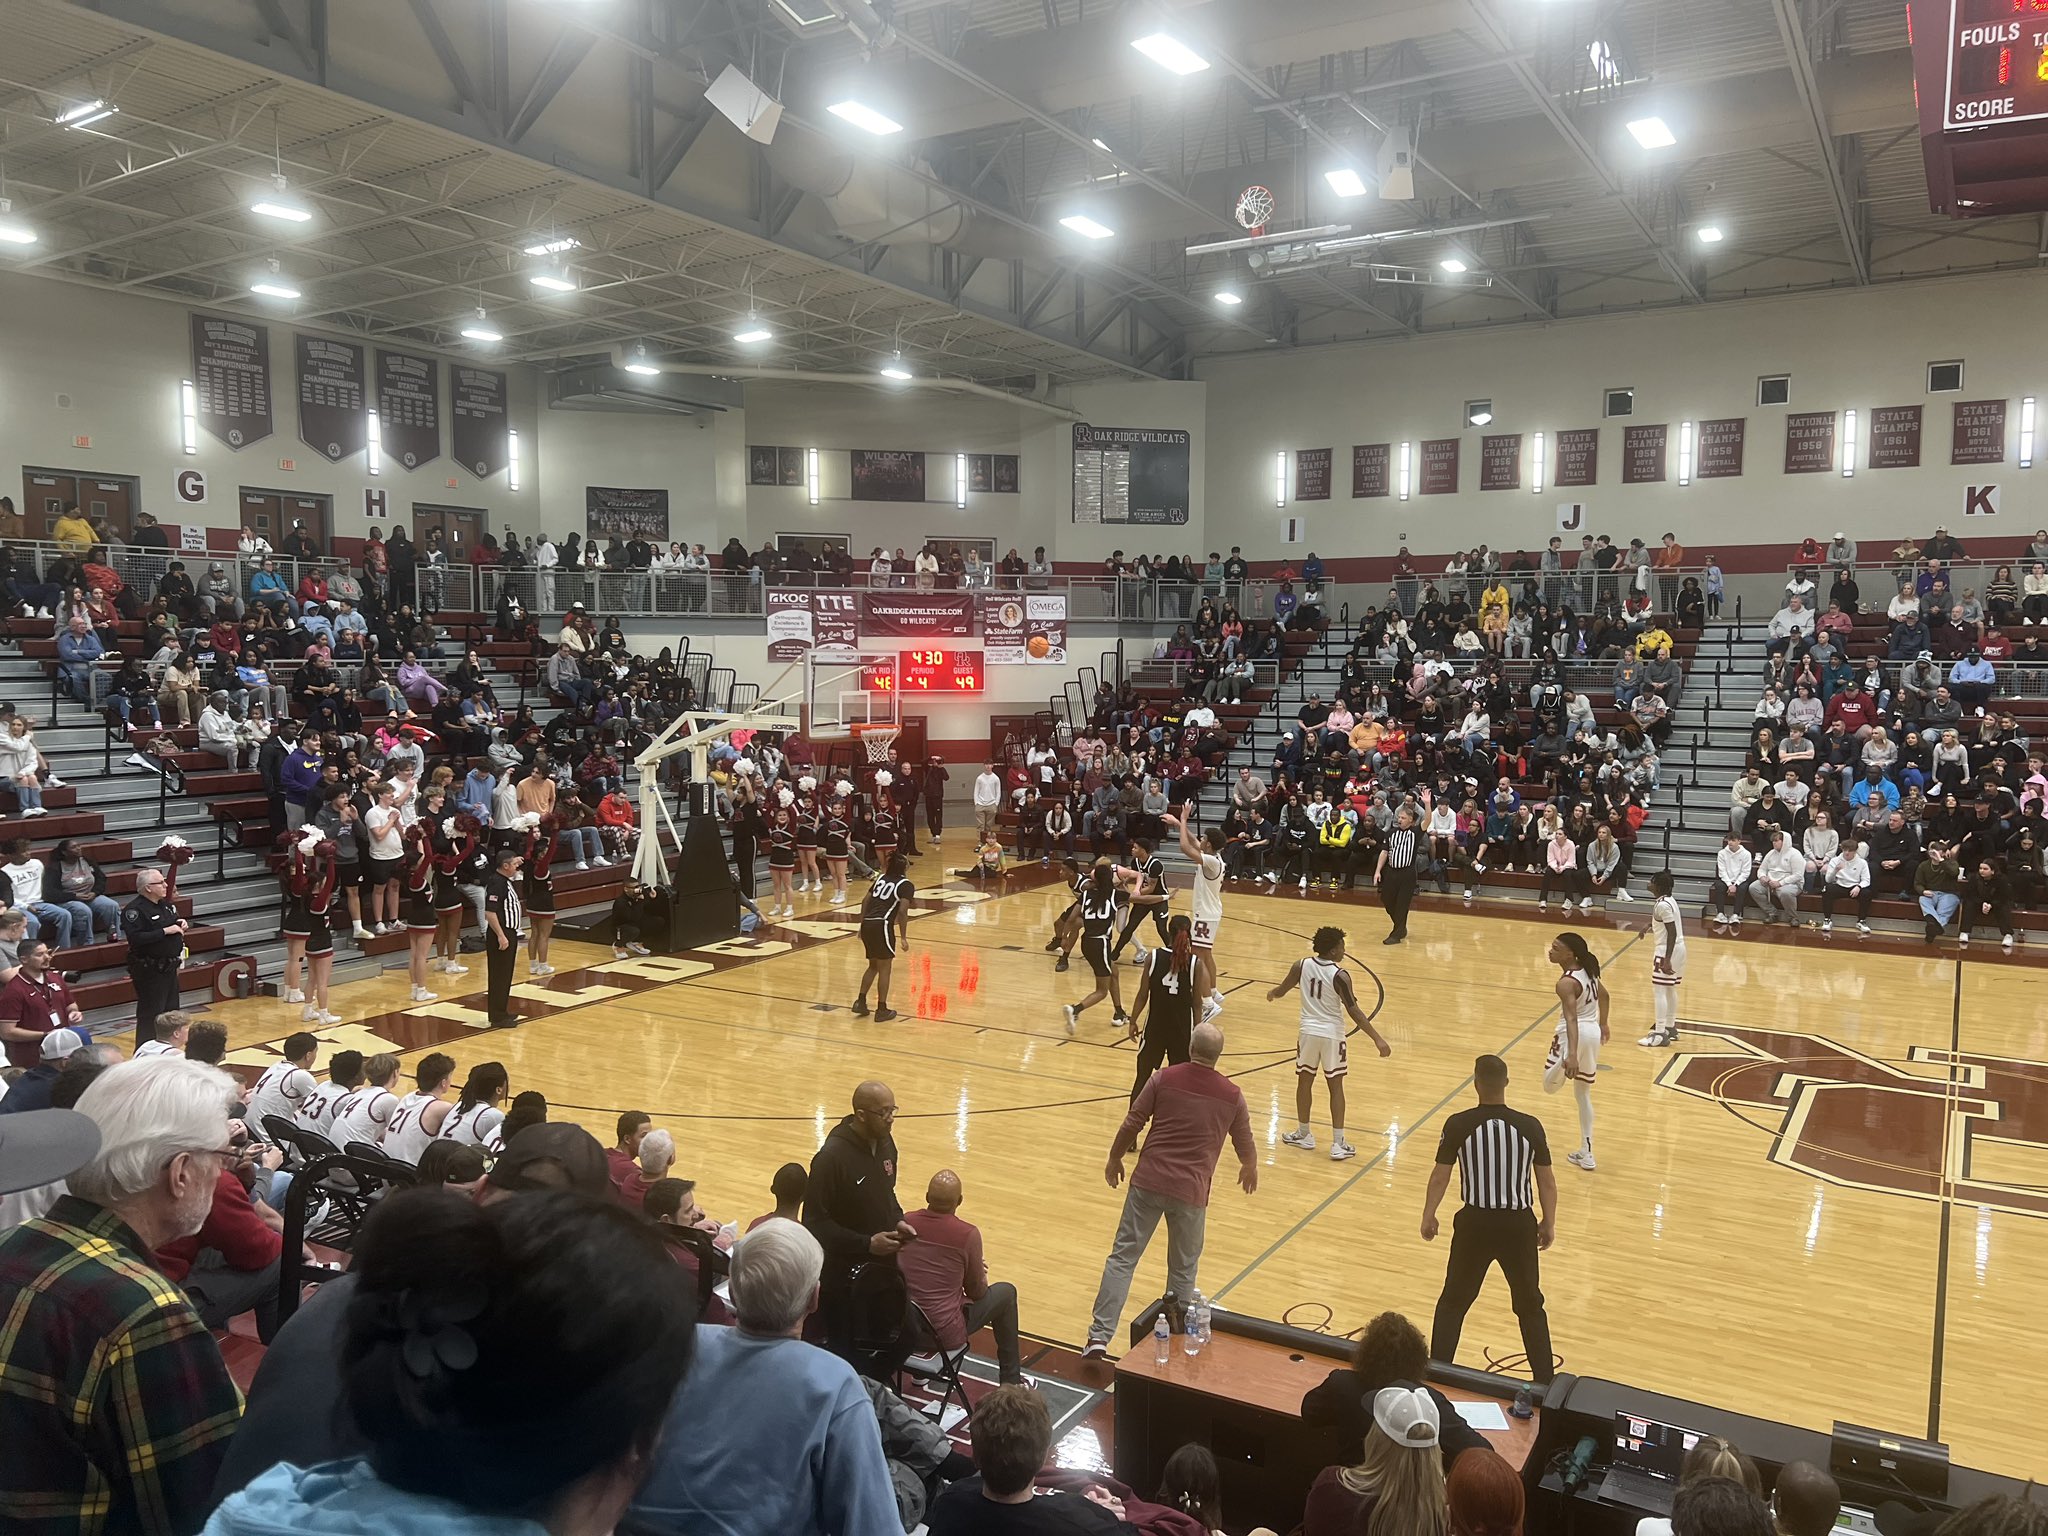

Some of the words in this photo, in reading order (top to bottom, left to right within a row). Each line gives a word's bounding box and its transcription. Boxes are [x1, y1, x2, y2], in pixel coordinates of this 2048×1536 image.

[1960, 22, 2020, 47] FOULS
[1955, 98, 2014, 120] SCORE
[214, 350, 250, 362] DISTRICT
[200, 356, 262, 372] CHAMPIONSHIPS
[304, 374, 359, 390] CHAMPIONSHIPS
[1962, 405, 1998, 415] STATE
[1789, 416, 1834, 427] NATIONAL
[1880, 411, 1914, 421] STATE
[1957, 415, 2003, 426] CHAMPS
[1706, 424, 1737, 433] STATE
[1790, 428, 1832, 438] CHAMPS
[1874, 422, 1919, 433] CHAMPS
[1968, 428, 1991, 437] 1961
[1094, 432, 1112, 441] OAK
[1114, 432, 1140, 442] RIDGE
[1140, 433, 1185, 444] WILDCATS
[1563, 434, 1591, 442] STATE
[1632, 430, 1660, 438] STATE
[1702, 434, 1740, 444] CHAMPS
[1488, 439, 1515, 447] STATE
[1627, 439, 1664, 448] CHAMPS
[1798, 441, 1822, 450] 1958
[1884, 436, 1906, 445] 1961
[1484, 448, 1518, 456] CHAMPS
[1559, 443, 1595, 452] CHAMPS
[1709, 447, 1732, 456] 1958
[1954, 446, 2002, 454] BASKETBALL
[864, 452, 913, 461] WILDCAT
[1302, 453, 1326, 461] STATE
[1356, 457, 1388, 465] CHAMPS
[1566, 453, 1587, 461] 1957
[1298, 461, 1329, 470] CHAMPS
[178, 470, 204, 502] G
[366, 489, 386, 517] H
[1966, 486, 1996, 514] K
[1562, 505, 1580, 530] J
[1289, 519, 1295, 541] I
[780, 594, 808, 603] KOC
[816, 595, 856, 610] TTE
[872, 607, 963, 616] OAKRIDGEATHLETICS.COM
[1032, 603, 1064, 611] OMEGA
[1624, 670, 1633, 679] T
[918, 677, 928, 689] 4
[956, 676, 975, 689] 49
[872, 880, 896, 900] 30
[1085, 899, 1110, 919] 20
[1162, 972, 1179, 994] 4
[1310, 978, 1322, 999] 11
[1586, 980, 1598, 1004] 20
[256, 1074, 272, 1094] 4
[301, 1092, 327, 1119] 23
[344, 1098, 359, 1118] 4
[388, 1108, 412, 1134] 21
[443, 1115, 463, 1138] 2
